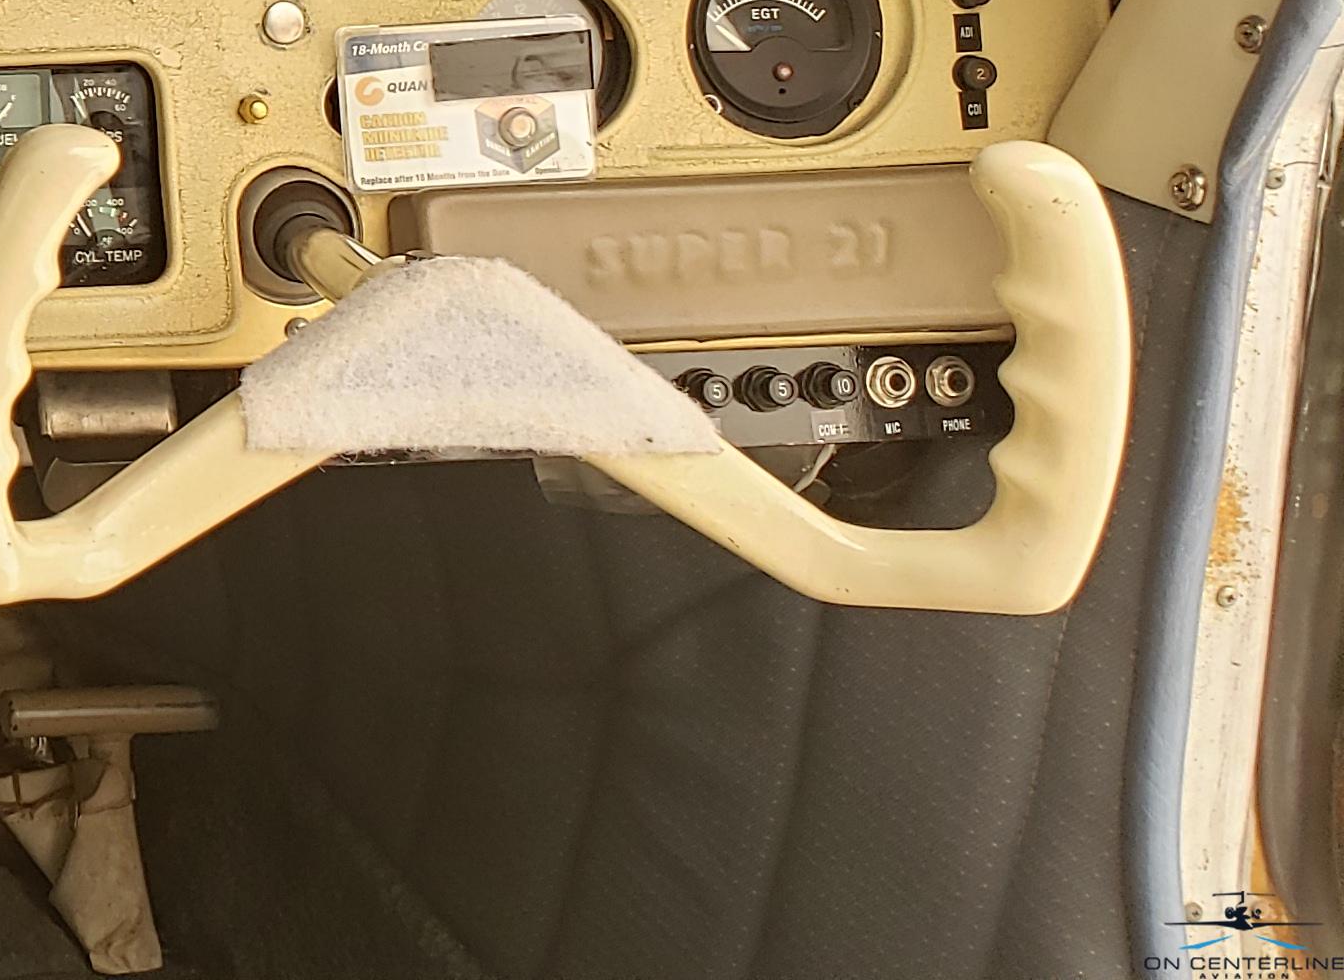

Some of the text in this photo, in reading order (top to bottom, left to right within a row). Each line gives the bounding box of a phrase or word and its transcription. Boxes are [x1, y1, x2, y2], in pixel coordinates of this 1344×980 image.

[751, 7, 779, 20] EGT
[960, 26, 974, 38] ADI
[351, 41, 411, 56] 18-Month
[968, 102, 982, 116] CDI
[584, 220, 889, 280] SUPER 21
[885, 422, 902, 434] MIC
[942, 418, 971, 432] PHONE
